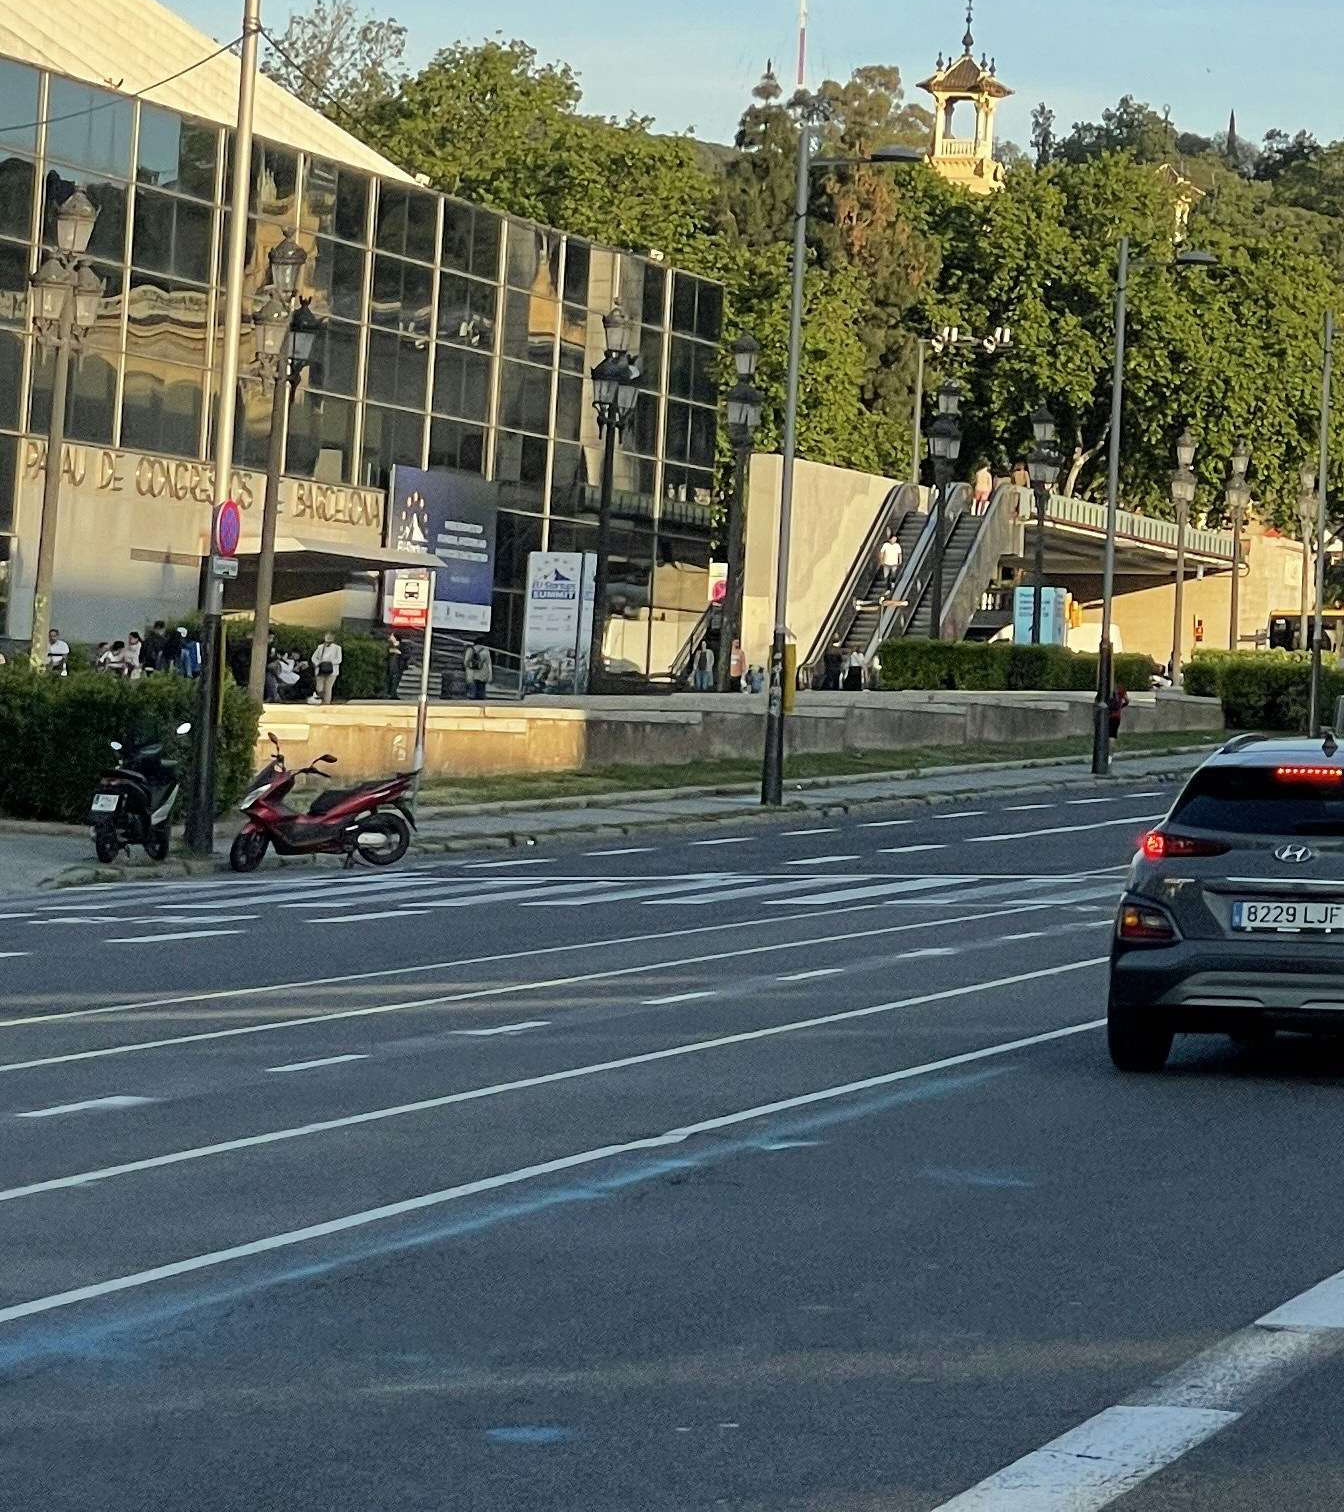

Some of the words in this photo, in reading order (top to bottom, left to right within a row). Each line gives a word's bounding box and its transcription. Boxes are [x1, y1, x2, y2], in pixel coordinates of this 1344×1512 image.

[23, 441, 86, 486] PAAU
[98, 451, 125, 491] DE
[136, 456, 253, 510] CONGRESOS
[293, 483, 381, 528] BARCELONA
[1246, 905, 1297, 924] 8229
[1303, 905, 1342, 925] LJF
